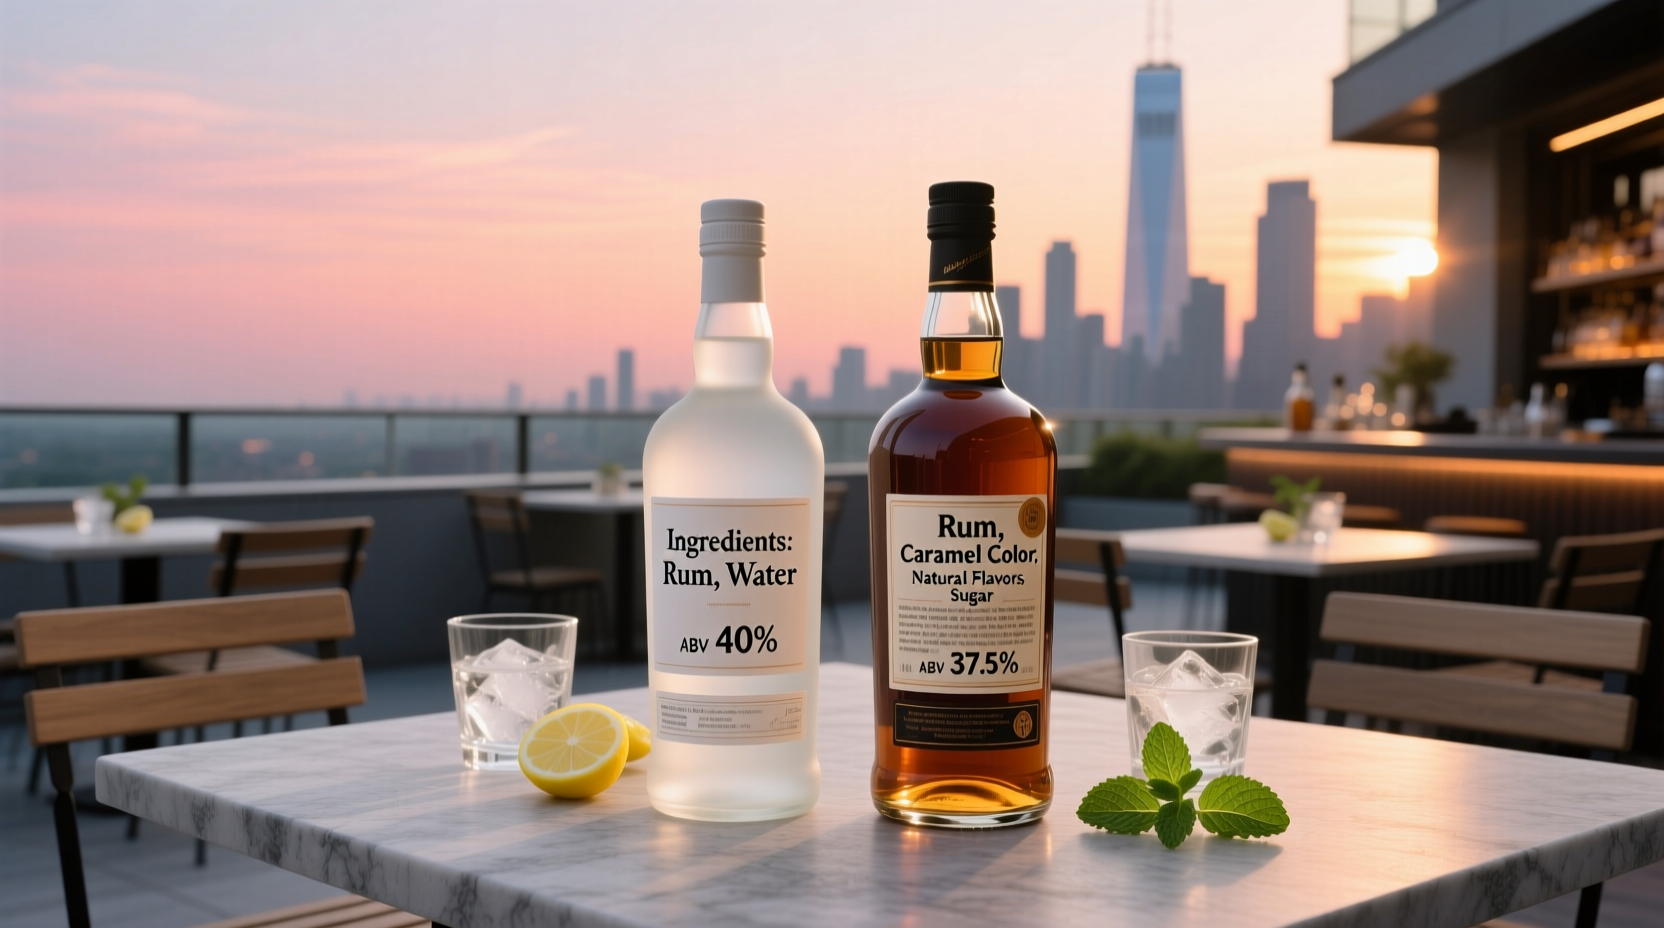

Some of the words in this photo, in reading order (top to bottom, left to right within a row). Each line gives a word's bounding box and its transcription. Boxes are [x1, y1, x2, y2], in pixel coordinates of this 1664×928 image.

[937, 514, 1004, 543] Rum,
[666, 528, 793, 558] Ingredients:
[900, 544, 981, 564] Caramel
[987, 544, 1038, 564] Color,
[662, 561, 720, 591] Rum,
[725, 561, 797, 586] Water
[912, 570, 967, 585] Natural
[950, 588, 994, 606] Sugar
[680, 637, 709, 653] ABV
[715, 624, 778, 654] 40%
[919, 661, 945, 674] ABV
[950, 650, 1019, 675] 37.5%
